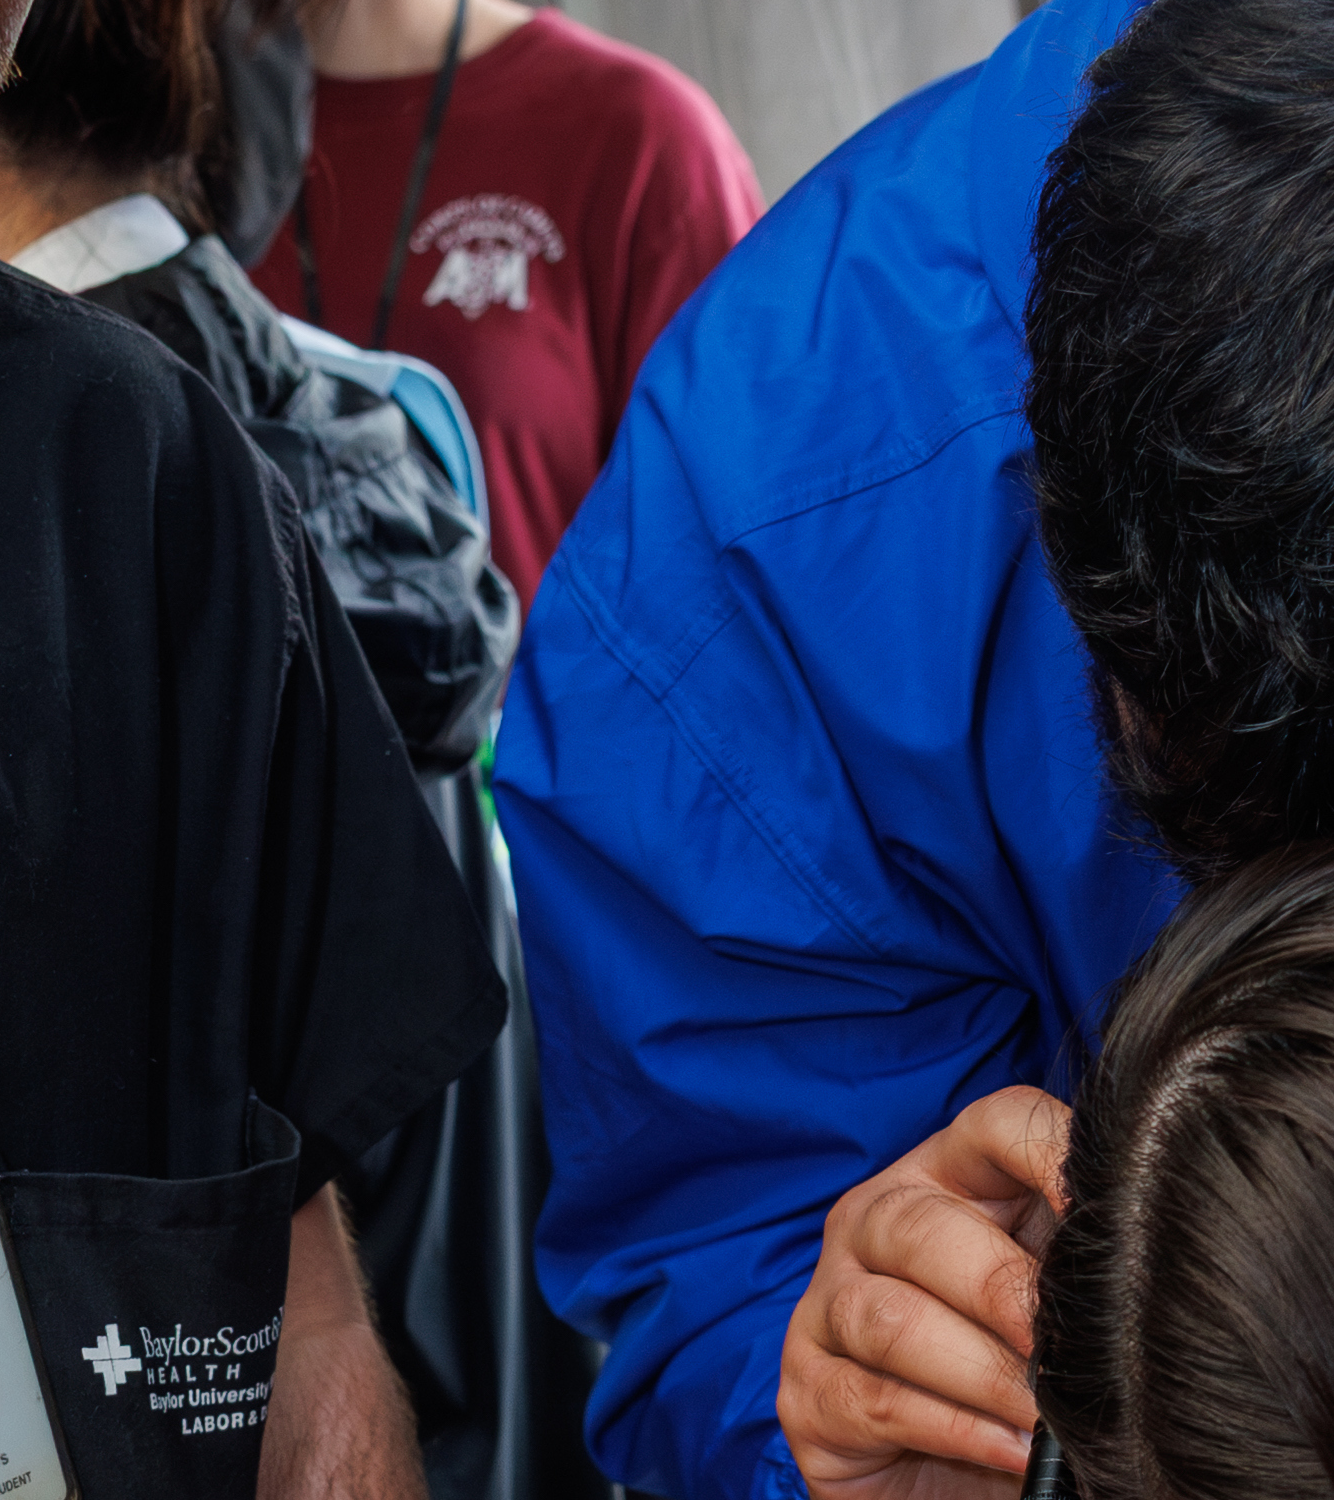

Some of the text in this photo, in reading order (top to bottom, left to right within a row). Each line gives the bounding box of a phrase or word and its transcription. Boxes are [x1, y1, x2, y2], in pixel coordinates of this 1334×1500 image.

[146, 1363, 241, 1386] HEALTH
[149, 1391, 185, 1414] Baylor
[188, 1381, 269, 1407] University
[181, 1411, 245, 1436] LABOR
[247, 1409, 258, 1427] &
